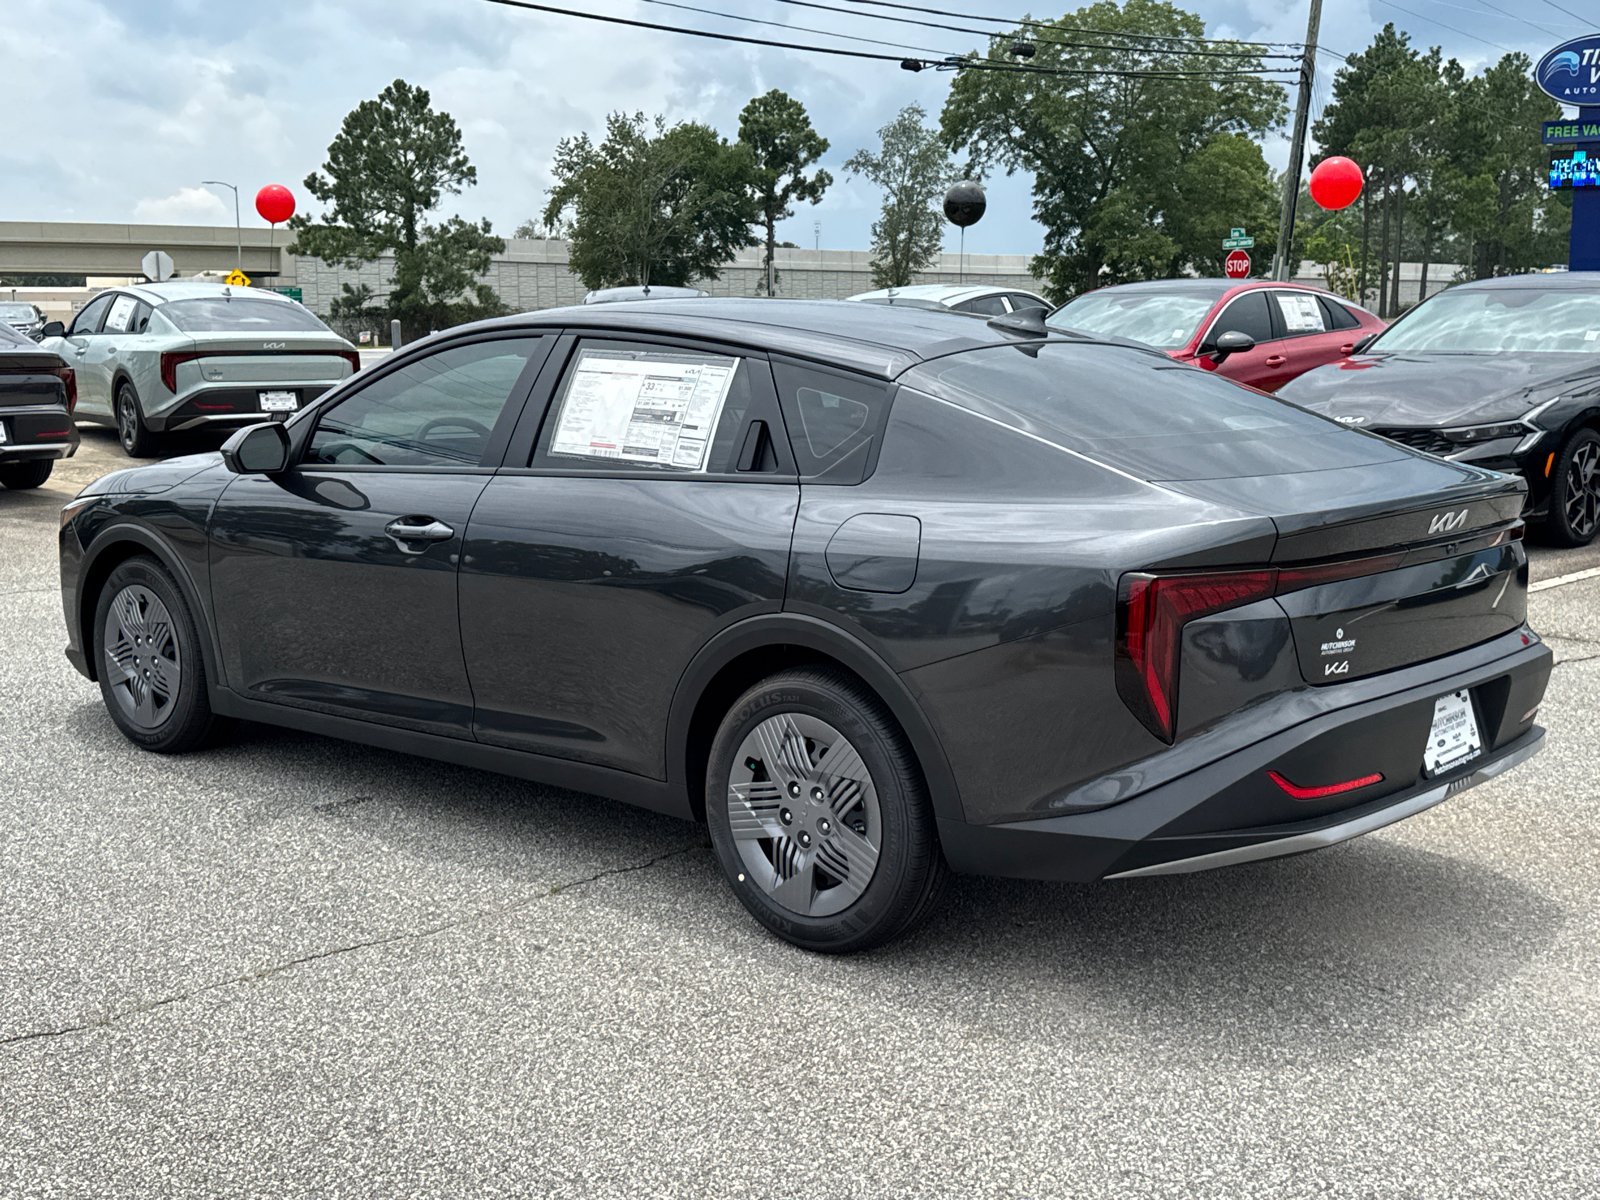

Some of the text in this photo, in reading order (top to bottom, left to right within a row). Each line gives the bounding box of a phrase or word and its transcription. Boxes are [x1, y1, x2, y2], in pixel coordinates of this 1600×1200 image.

[1582, 48, 1600, 66] TI
[1564, 87, 1597, 95] AUTO
[1546, 125, 1579, 138] FREE
[1227, 260, 1249, 272] STOP
[645, 382, 655, 391] 33
[1428, 509, 1469, 534] KIA
[1321, 640, 1356, 651] HUTCHINSON
[1325, 660, 1349, 676] K4
[732, 692, 800, 730] SOLUS TA31
[1432, 707, 1466, 731] HUTCHINSON
